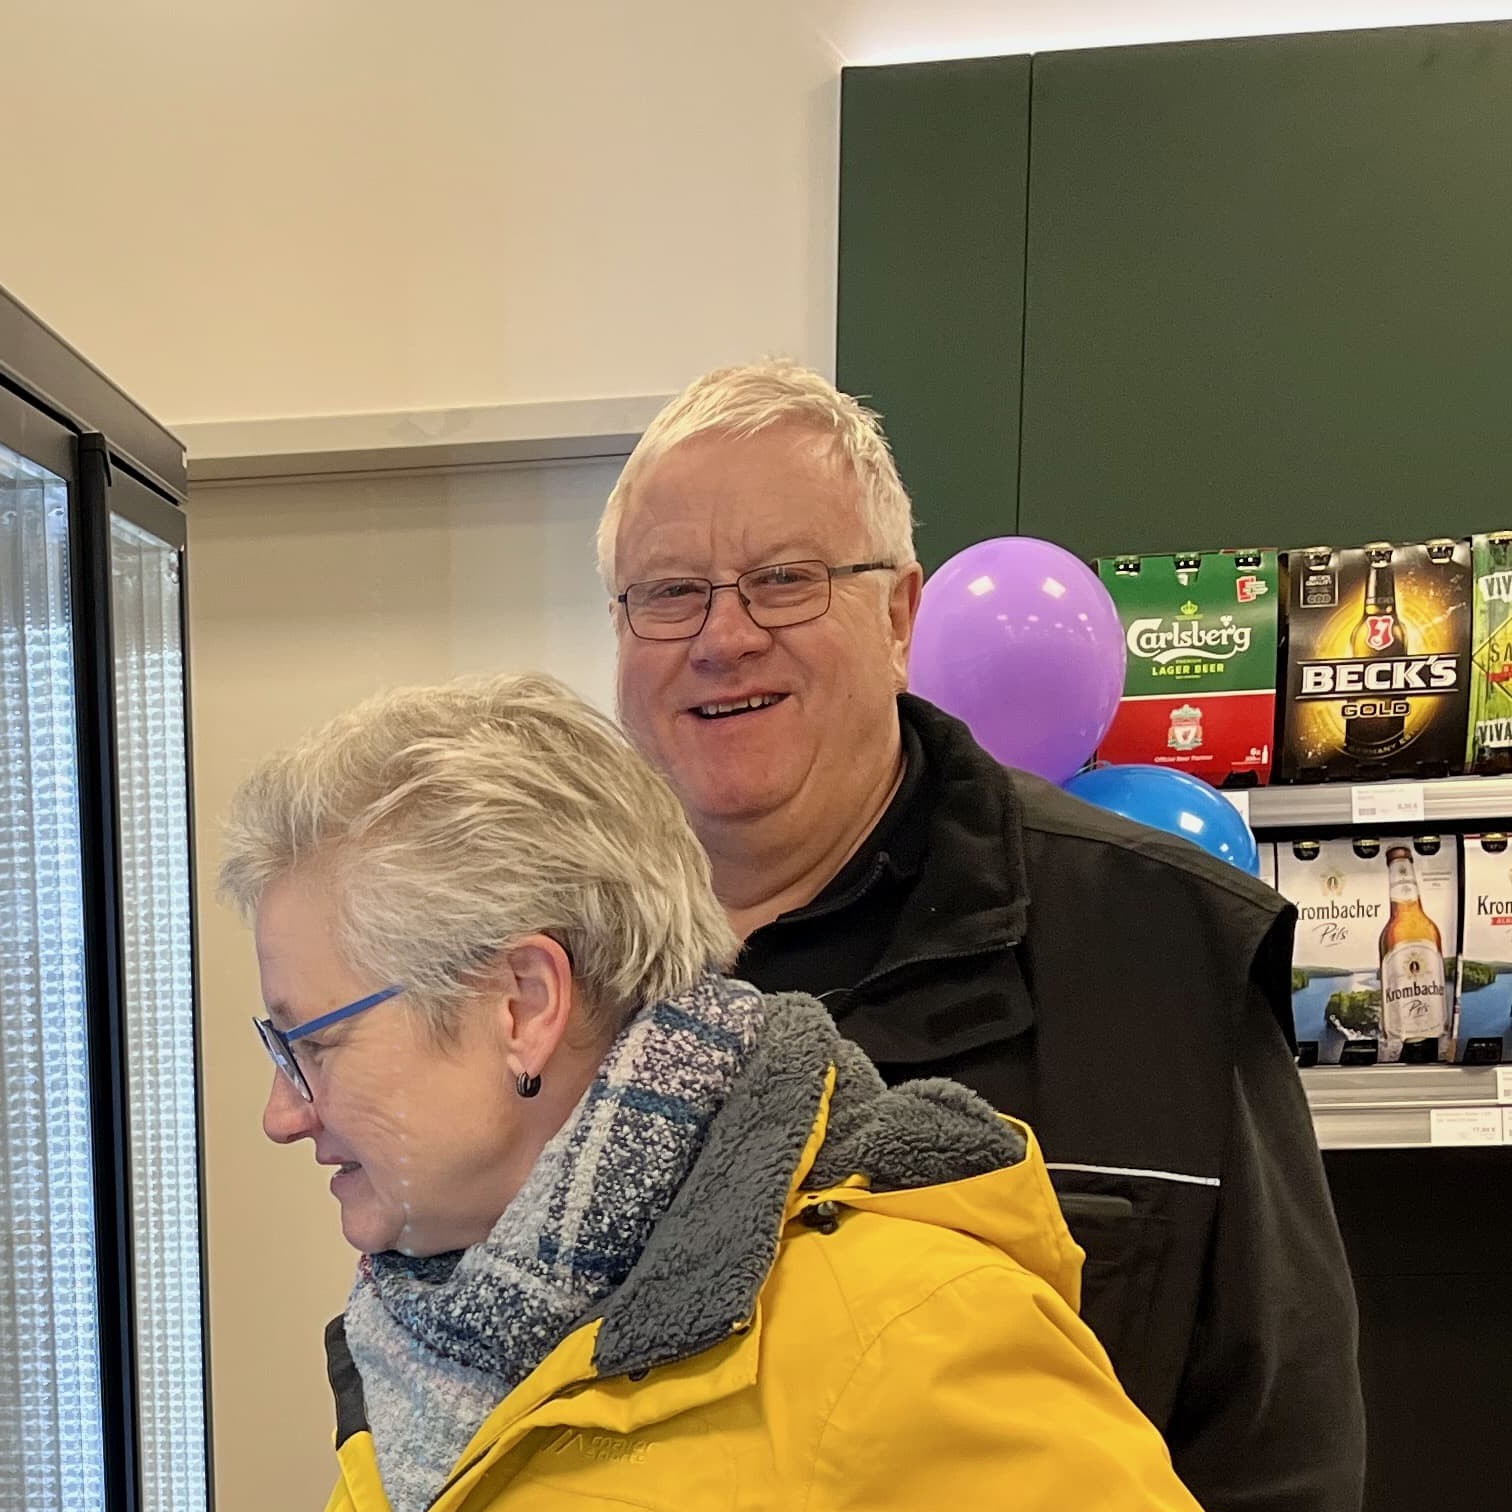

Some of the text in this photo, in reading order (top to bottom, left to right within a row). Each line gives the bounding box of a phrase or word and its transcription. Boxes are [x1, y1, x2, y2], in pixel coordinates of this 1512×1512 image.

[1126, 616, 1252, 660] Carlsberg
[1152, 663, 1224, 676] LAGER BEER
[1301, 656, 1457, 693] BECK'S
[1341, 701, 1411, 719] GOLD
[1313, 923, 1348, 947] Pils
